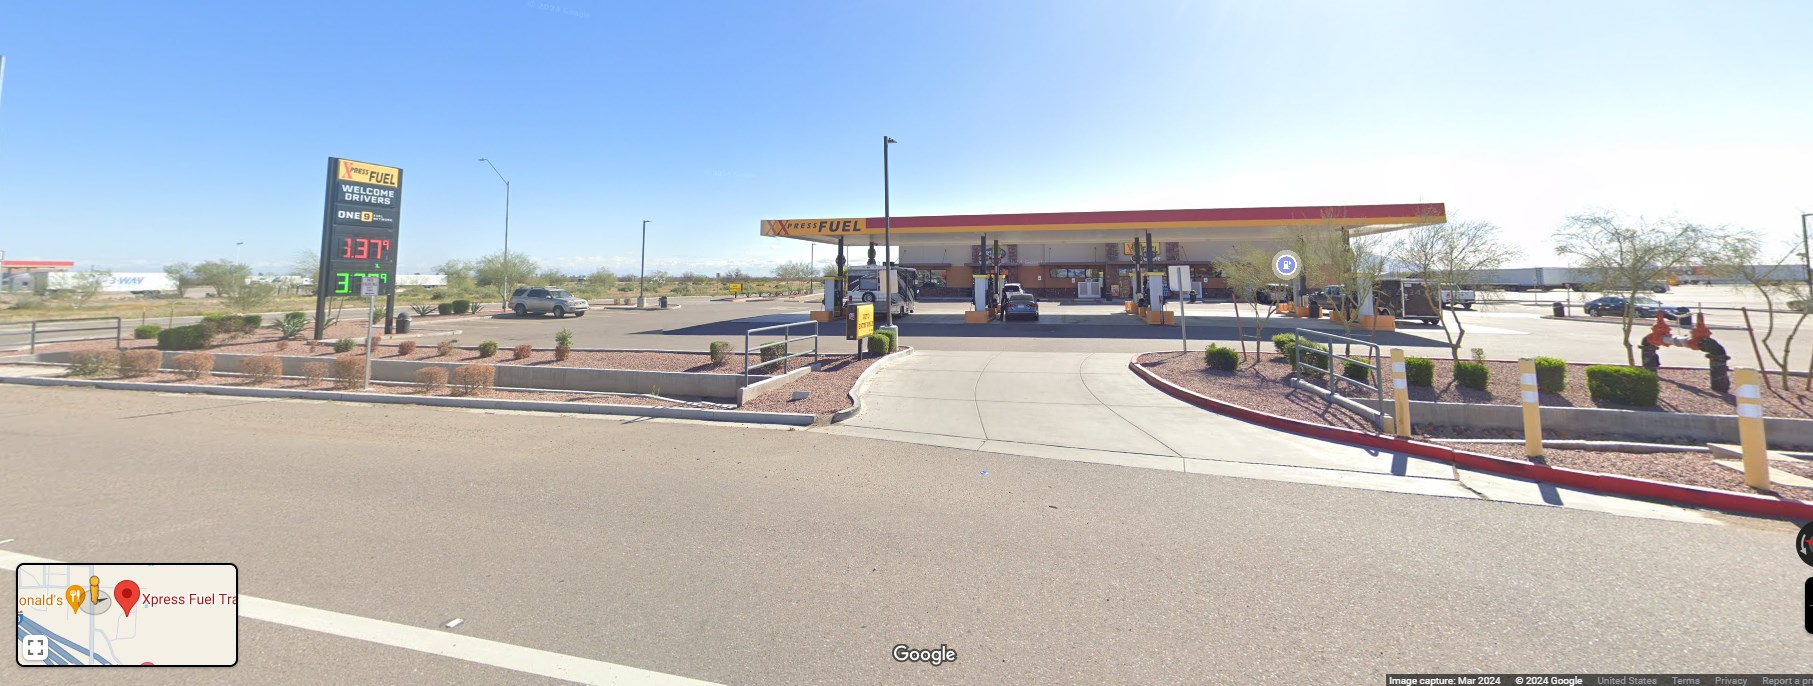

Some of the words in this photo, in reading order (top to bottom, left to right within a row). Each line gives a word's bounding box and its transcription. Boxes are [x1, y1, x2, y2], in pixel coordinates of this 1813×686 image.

[369, 171, 395, 185] FUEL
[342, 184, 395, 198] WELCOME
[345, 193, 391, 205] DRIVERS
[818, 220, 861, 232] FUEL
